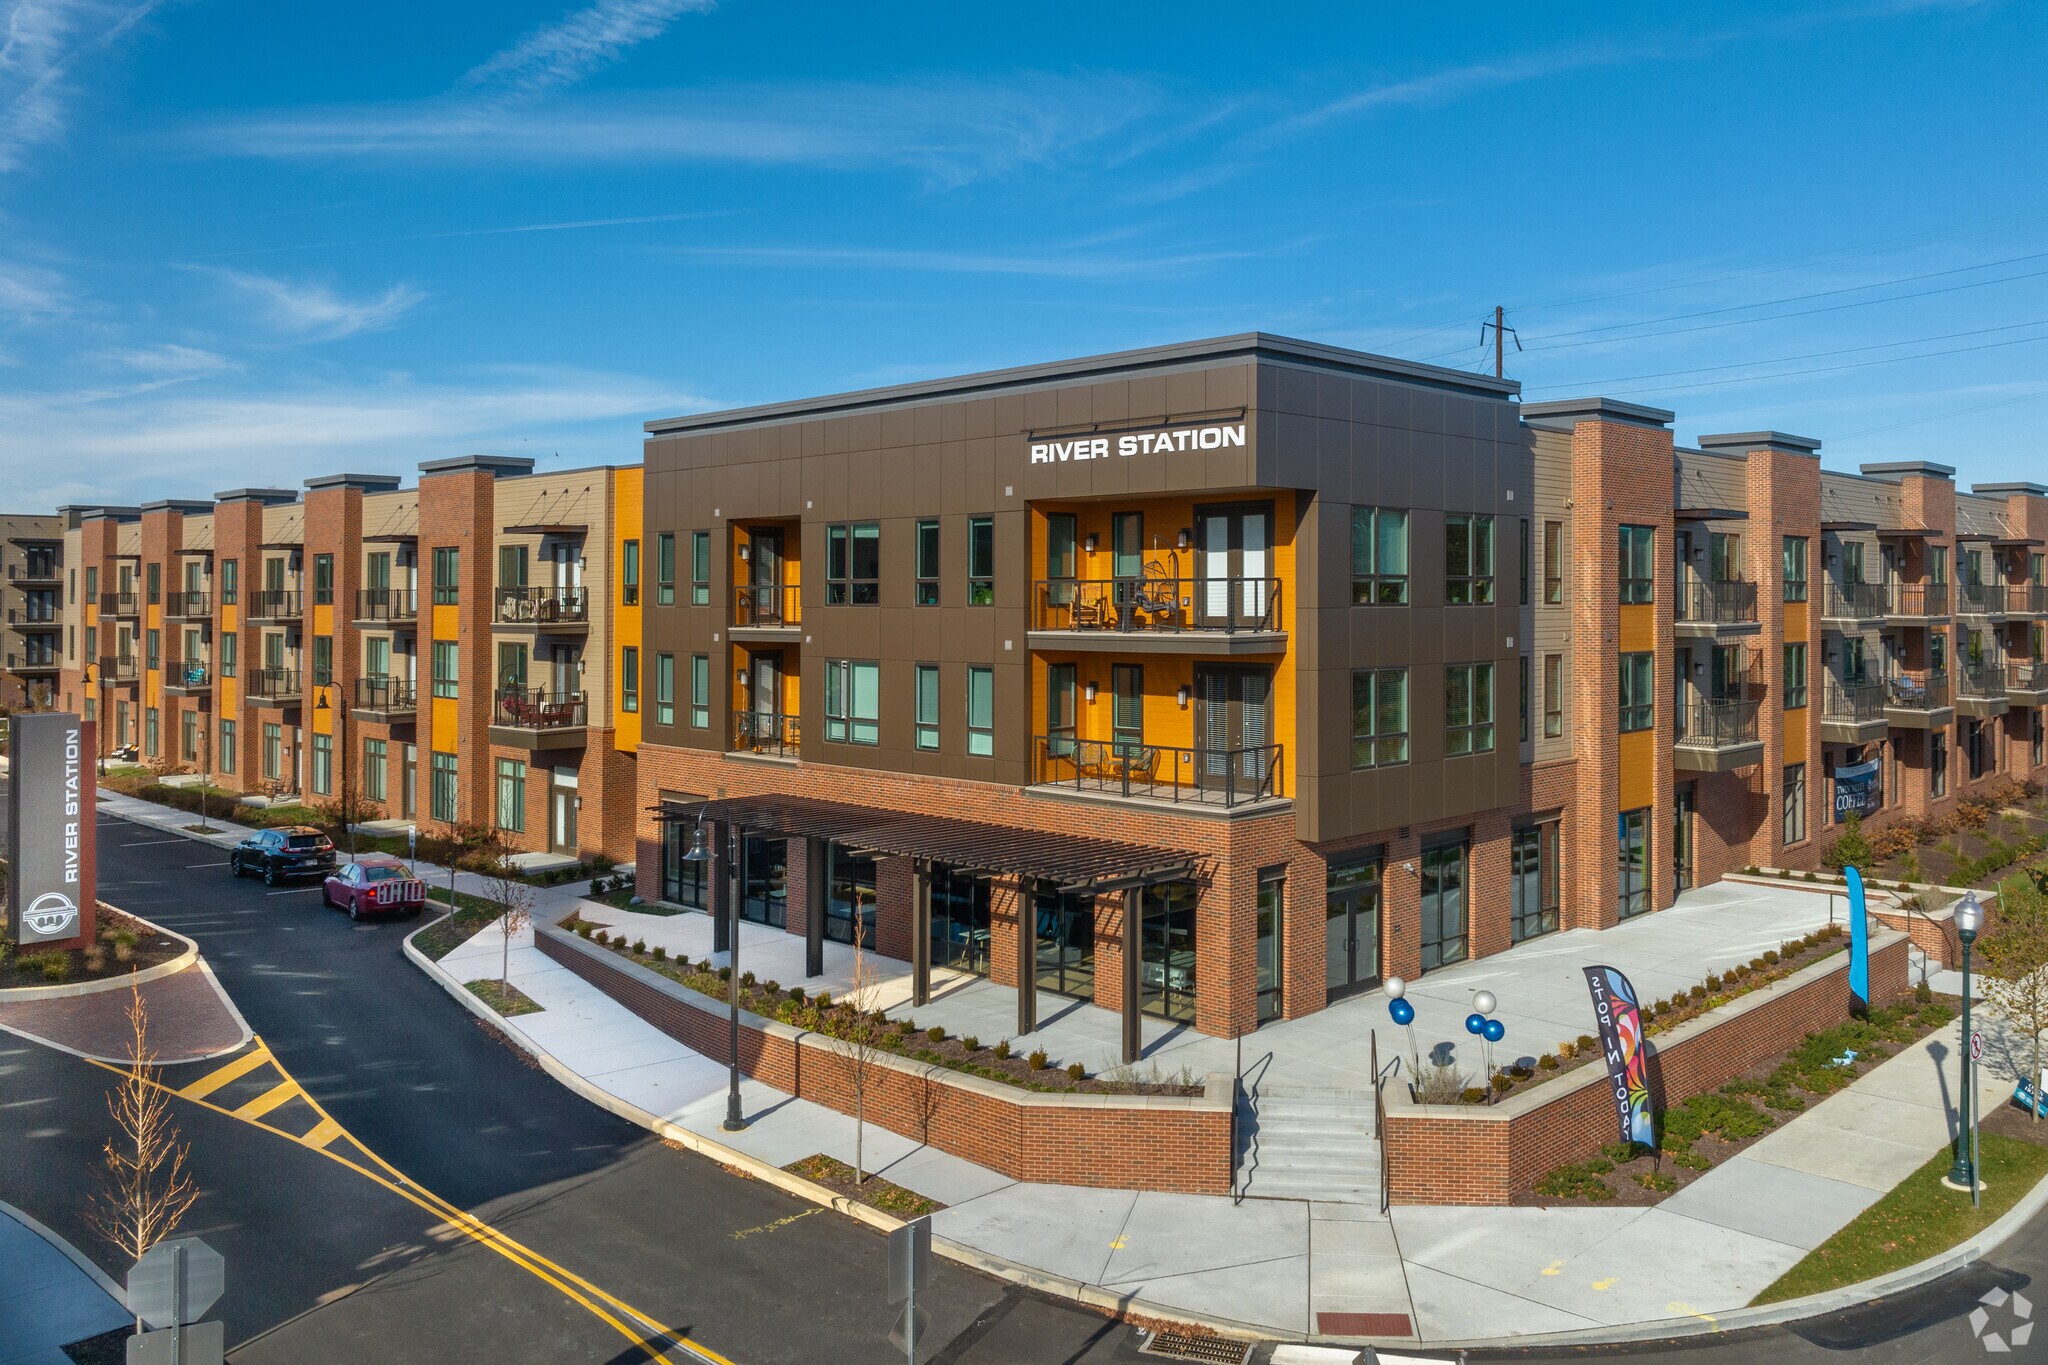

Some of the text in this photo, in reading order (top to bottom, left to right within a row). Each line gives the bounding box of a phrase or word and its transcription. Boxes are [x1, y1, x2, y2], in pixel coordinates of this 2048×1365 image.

[1031, 425, 1246, 464] RIVER STATION
[65, 729, 79, 883] RIVER STATION
[1836, 791, 1866, 810] COFFEE
